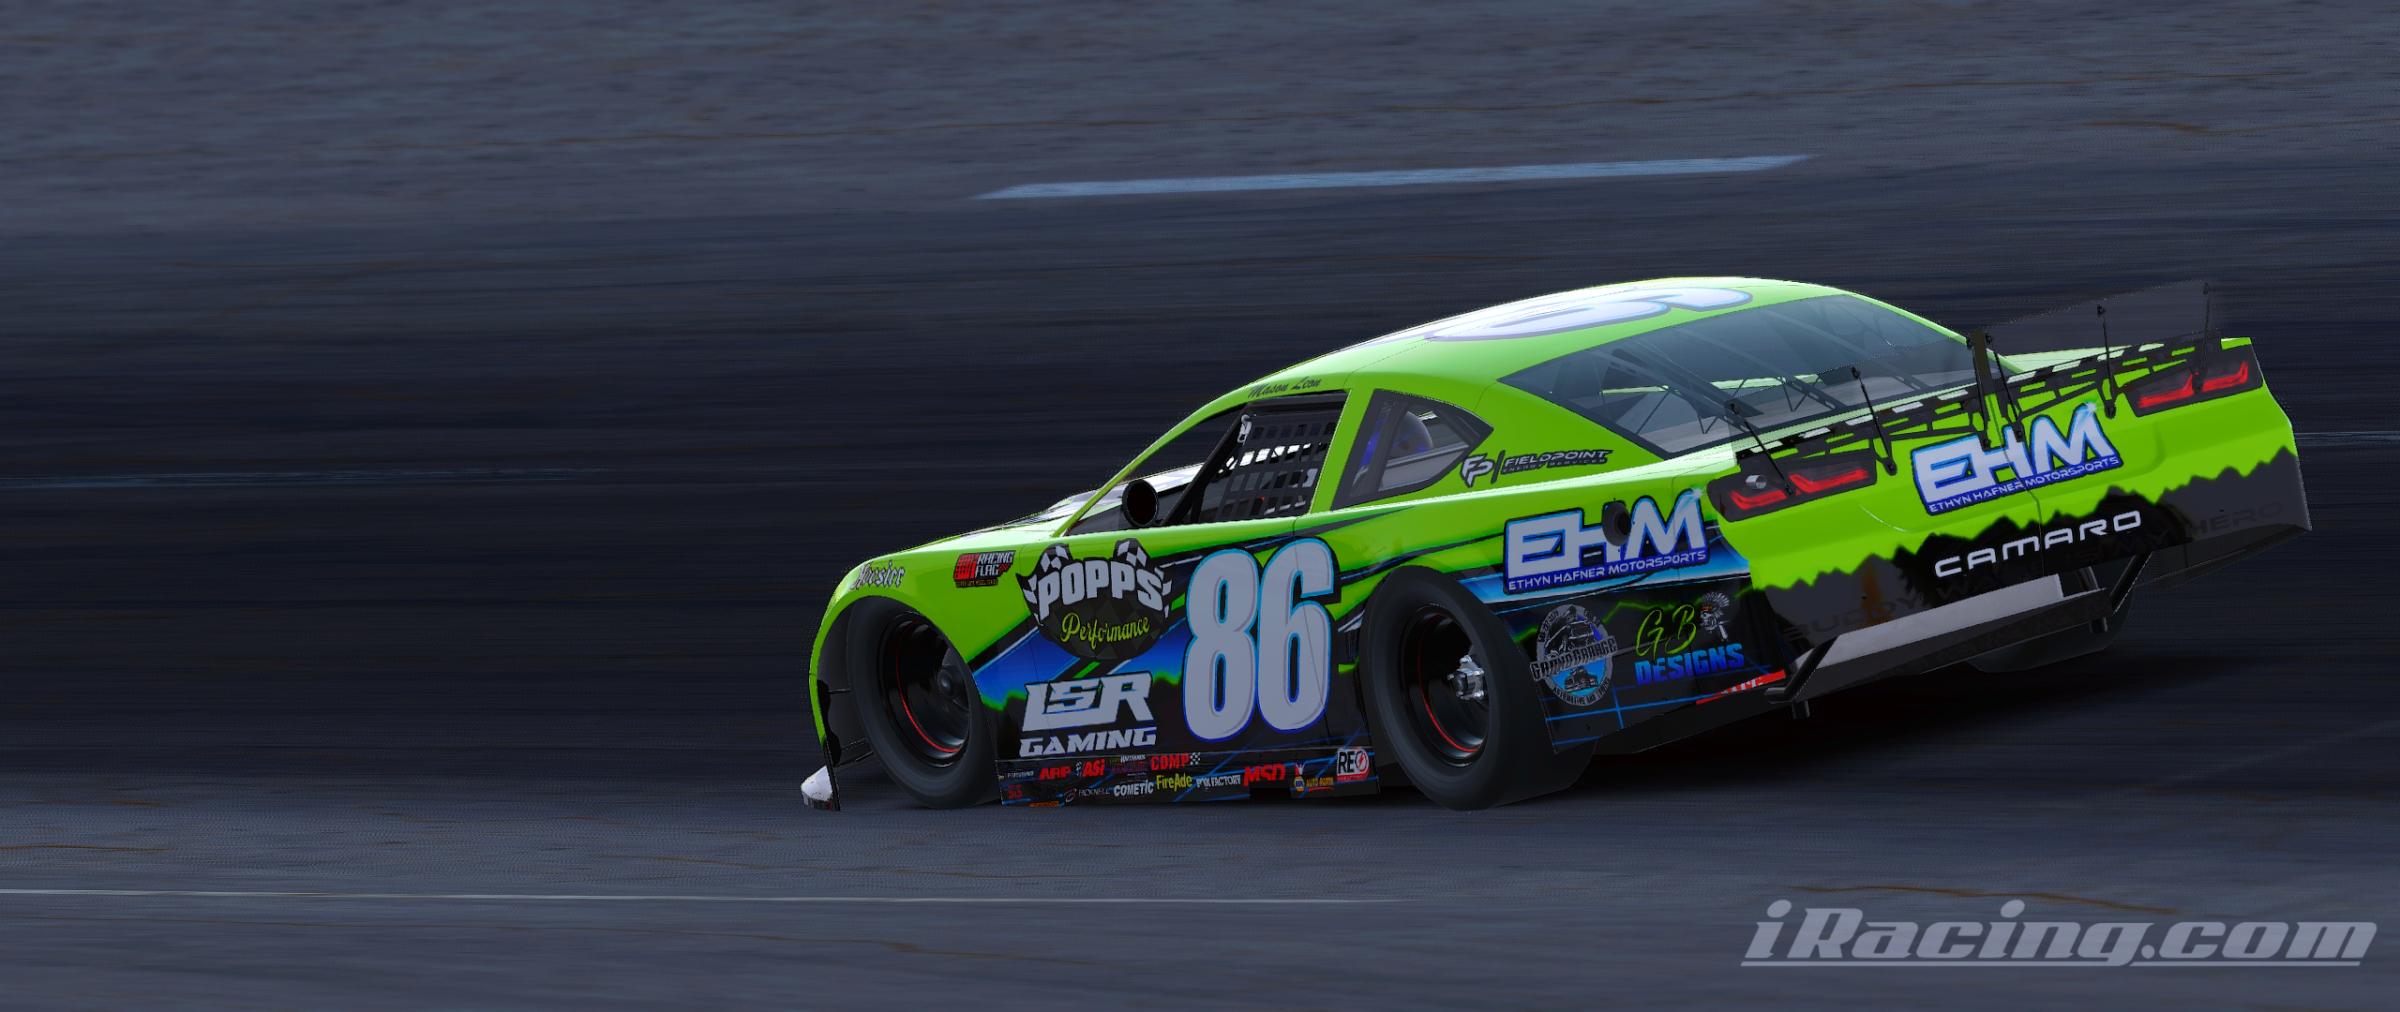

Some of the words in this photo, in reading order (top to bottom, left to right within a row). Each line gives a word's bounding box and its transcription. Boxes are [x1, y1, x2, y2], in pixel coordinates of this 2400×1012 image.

[1504, 451, 1609, 467] FIELDPOINT
[1913, 402, 2116, 503] EHM
[1929, 494, 1972, 513] ETHYN
[1974, 480, 2025, 501] HAFNER
[2025, 456, 2120, 487] MOTORSPORTS
[1507, 488, 1706, 578] EHM
[1934, 509, 2142, 579] CAMARO
[975, 564, 999, 577] FLAG
[977, 550, 1014, 564] RACING
[1508, 575, 1551, 591] ETHYN
[1553, 567, 1605, 584] HAFNER
[1608, 550, 1706, 576] MOTORSPORTS
[1038, 560, 1163, 621] POPPS
[1060, 612, 1151, 650] Performance
[1183, 537, 1334, 743] 86
[1634, 643, 1745, 686] DESIGNS
[1019, 727, 1157, 758] GAMING
[1151, 753, 1191, 771] COMP
[1156, 773, 1193, 792] FireAde
[1243, 762, 1286, 787] MSD
